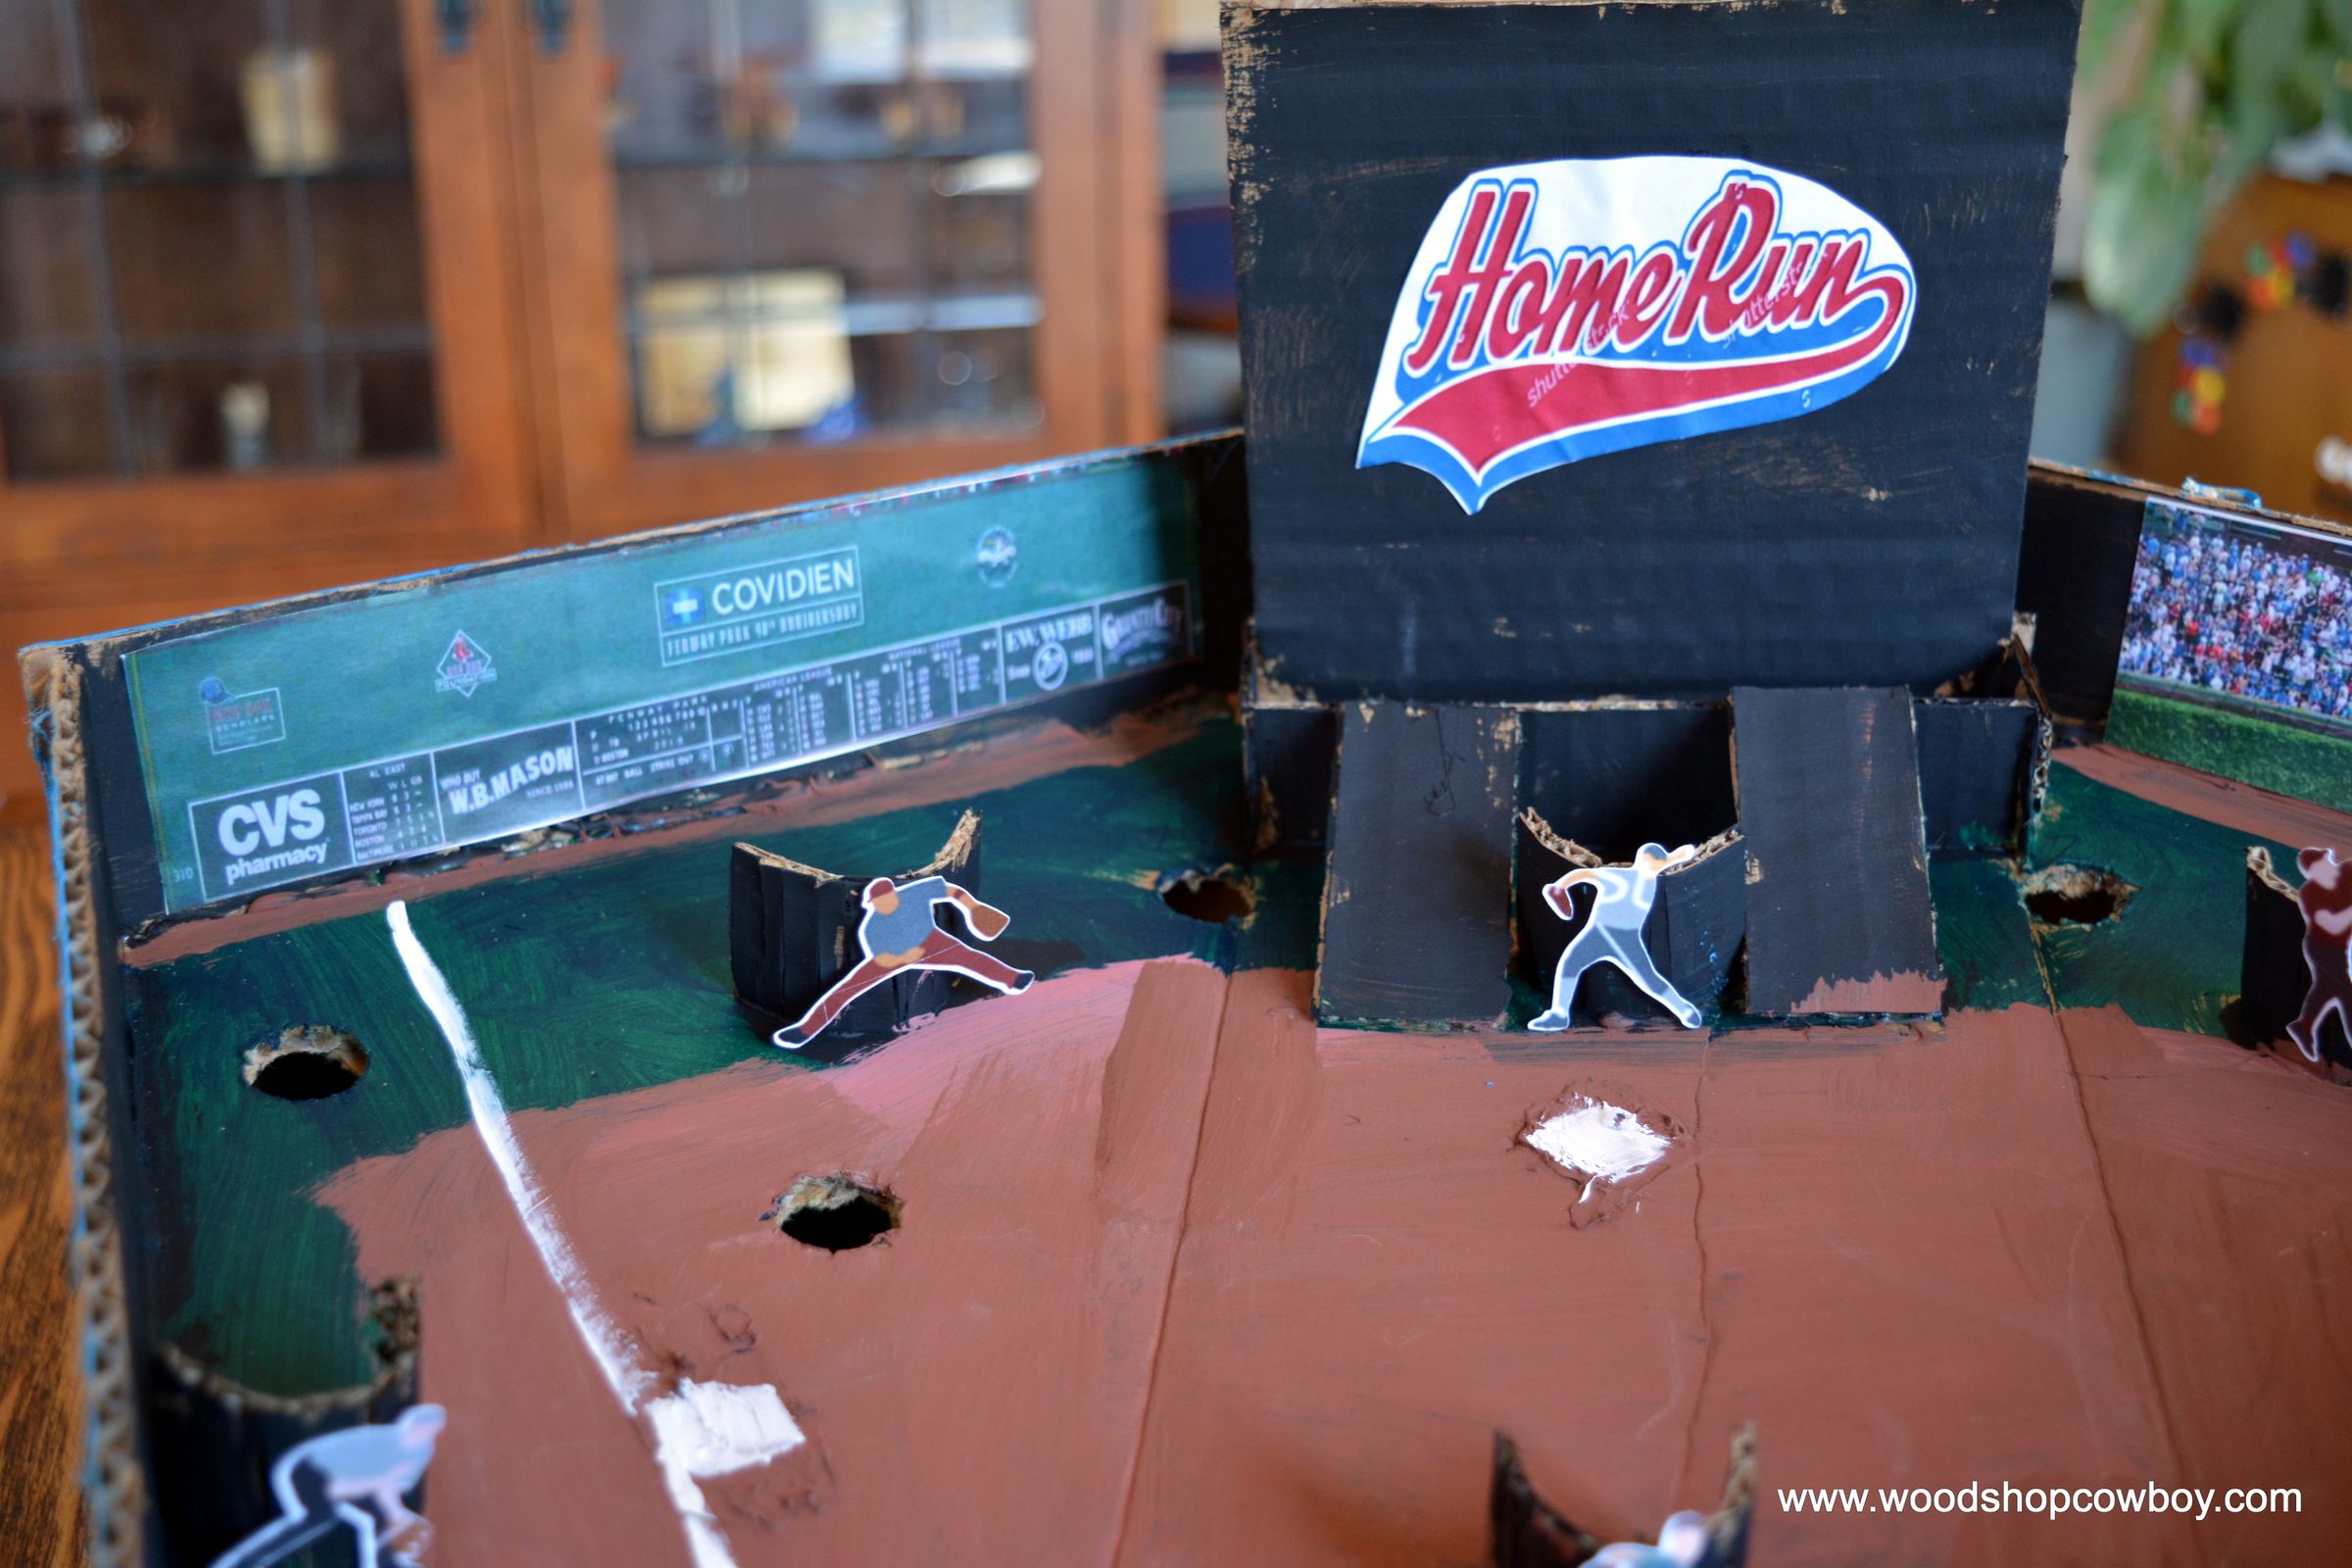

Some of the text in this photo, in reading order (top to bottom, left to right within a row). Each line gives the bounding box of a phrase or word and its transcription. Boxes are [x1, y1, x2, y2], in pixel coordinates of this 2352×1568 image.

[711, 557, 857, 615] COVIDIEN
[219, 788, 326, 858] CVS
[225, 838, 328, 886] pharmacy
